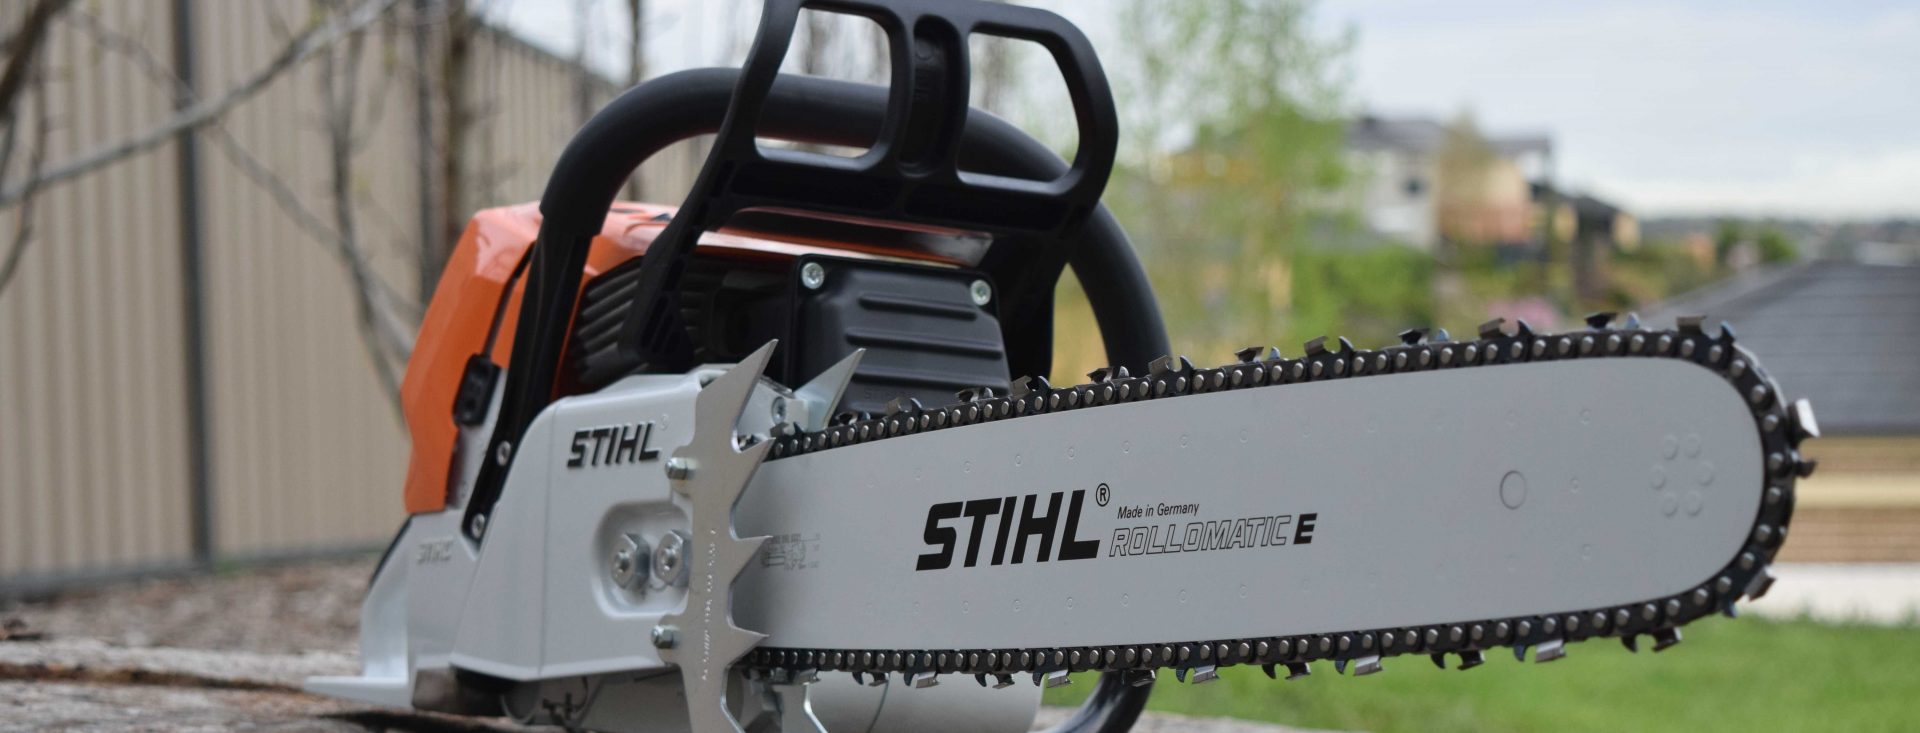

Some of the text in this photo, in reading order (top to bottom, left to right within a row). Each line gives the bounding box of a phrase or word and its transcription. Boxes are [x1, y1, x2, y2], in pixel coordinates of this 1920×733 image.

[567, 423, 659, 468] STIHL
[1117, 502, 1199, 520] Made in Germany
[1109, 513, 1318, 558] ROLLOMATIC E
